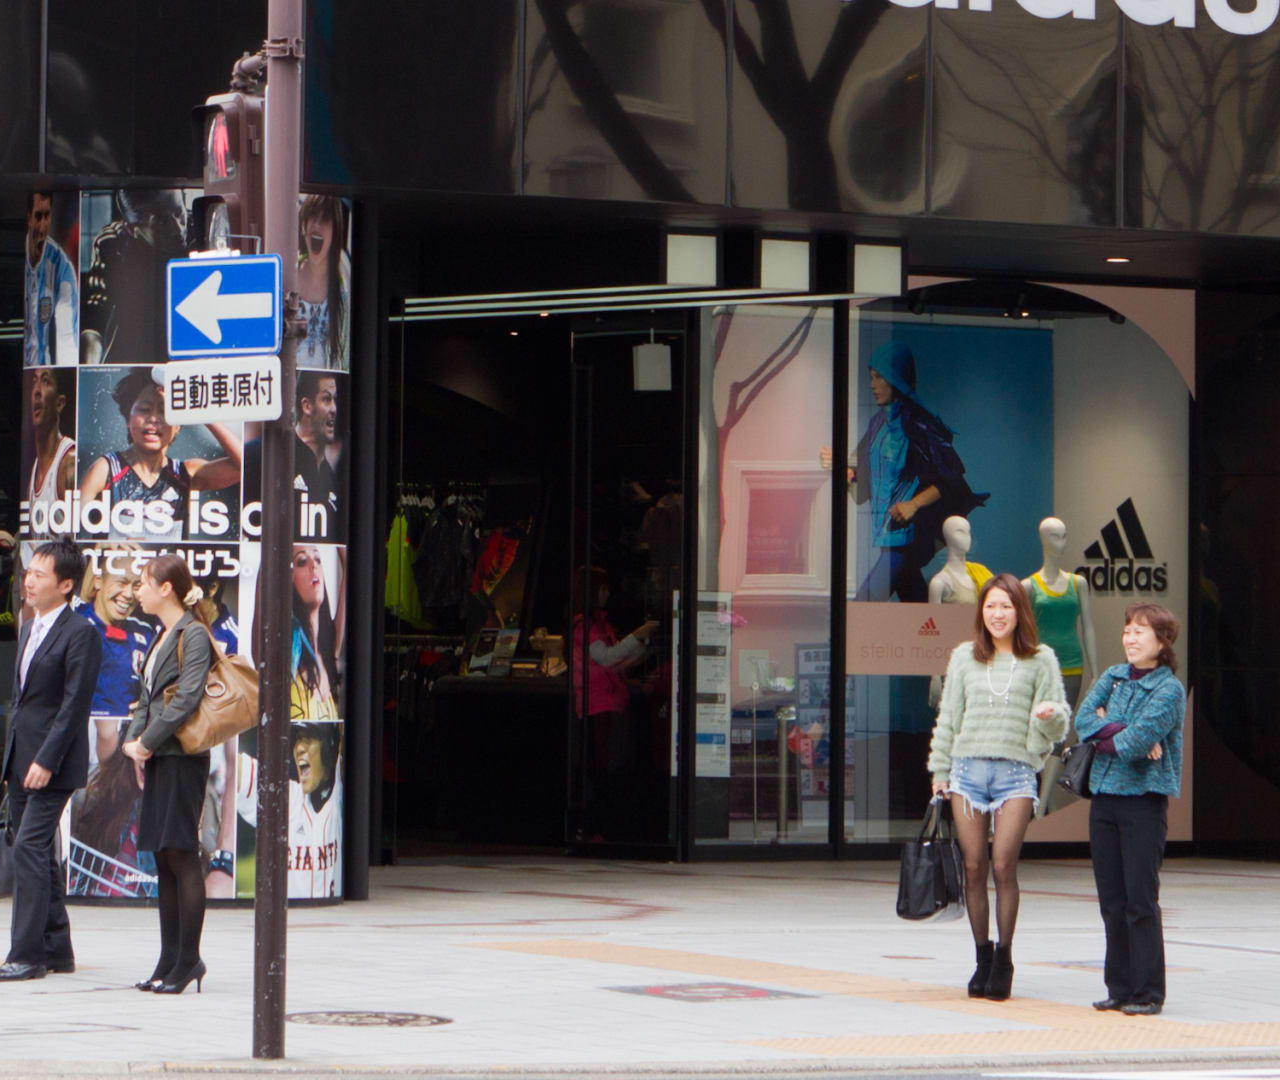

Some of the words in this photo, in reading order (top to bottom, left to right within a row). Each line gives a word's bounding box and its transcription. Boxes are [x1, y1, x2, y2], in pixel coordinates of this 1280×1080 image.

[31, 489, 175, 535] adidas
[189, 491, 230, 534] is
[301, 493, 327, 537] in
